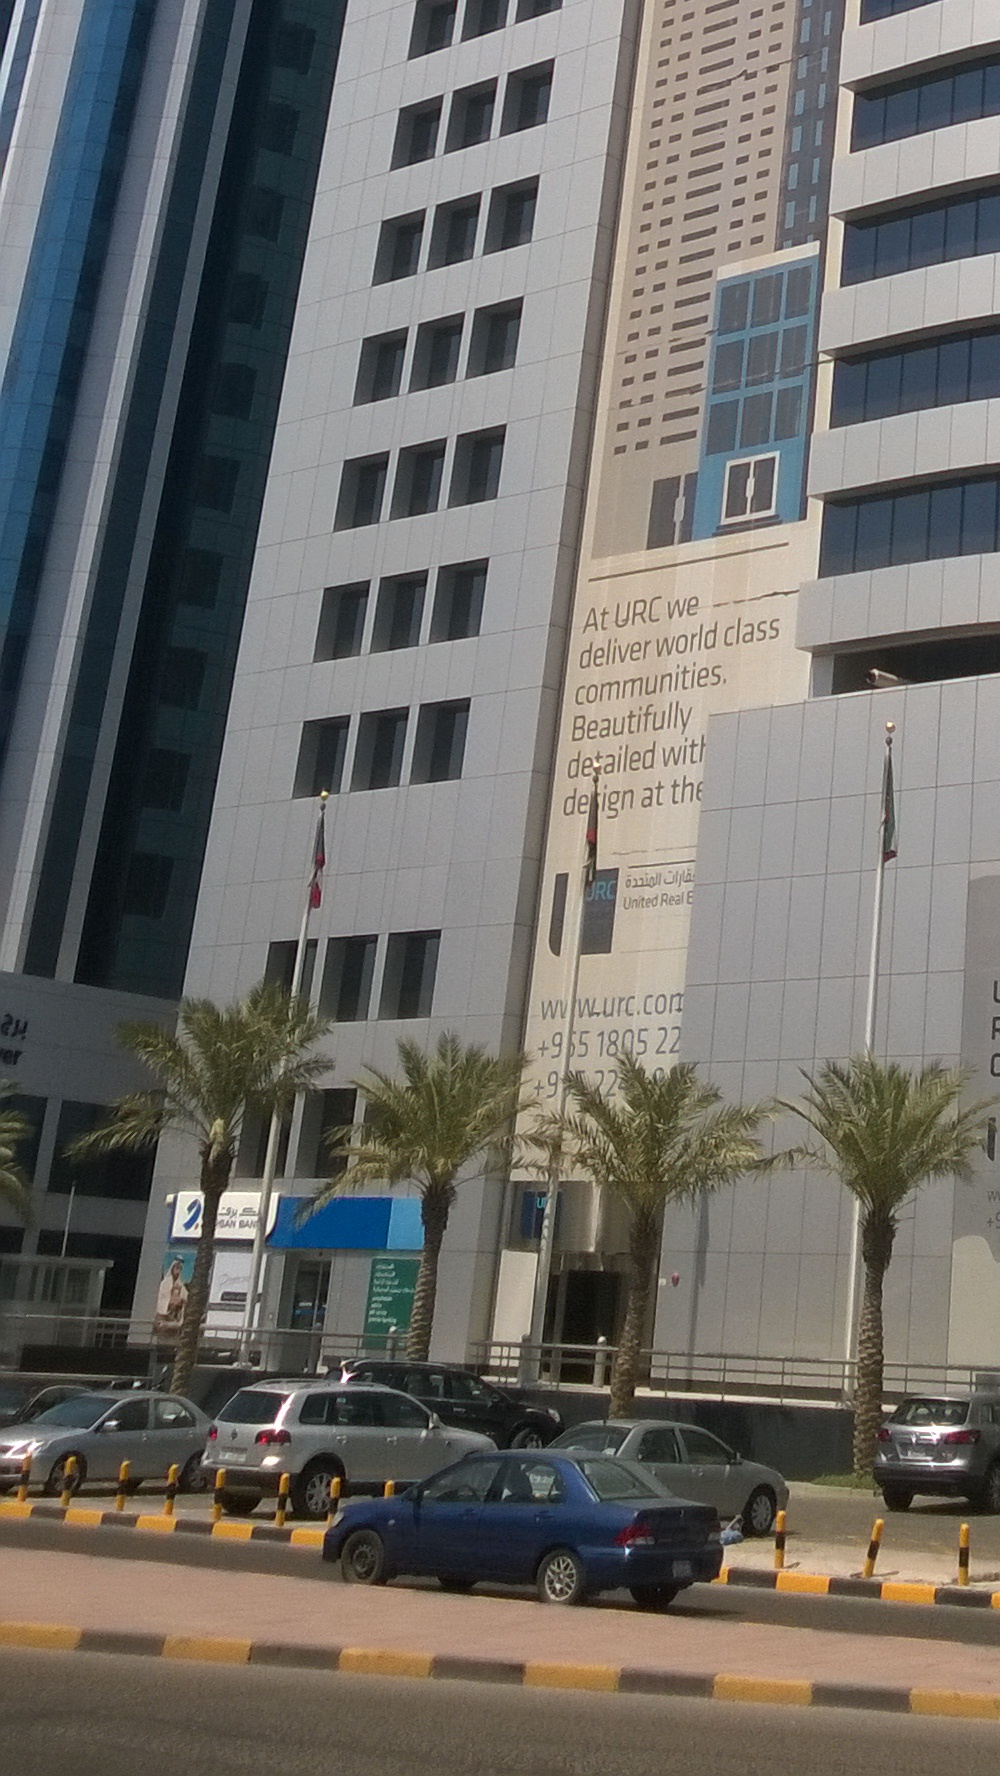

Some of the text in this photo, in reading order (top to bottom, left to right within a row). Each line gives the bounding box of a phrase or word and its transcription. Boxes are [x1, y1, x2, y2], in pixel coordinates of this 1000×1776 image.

[582, 595, 700, 634] At URC we
[578, 616, 781, 670] deliver world class
[574, 661, 728, 706] communities.
[571, 700, 693, 742] Beautifully
[567, 740, 657, 779] detailed
[563, 775, 704, 820] deign at the
[623, 893, 659, 911] United
[660, 890, 684, 907] Real
